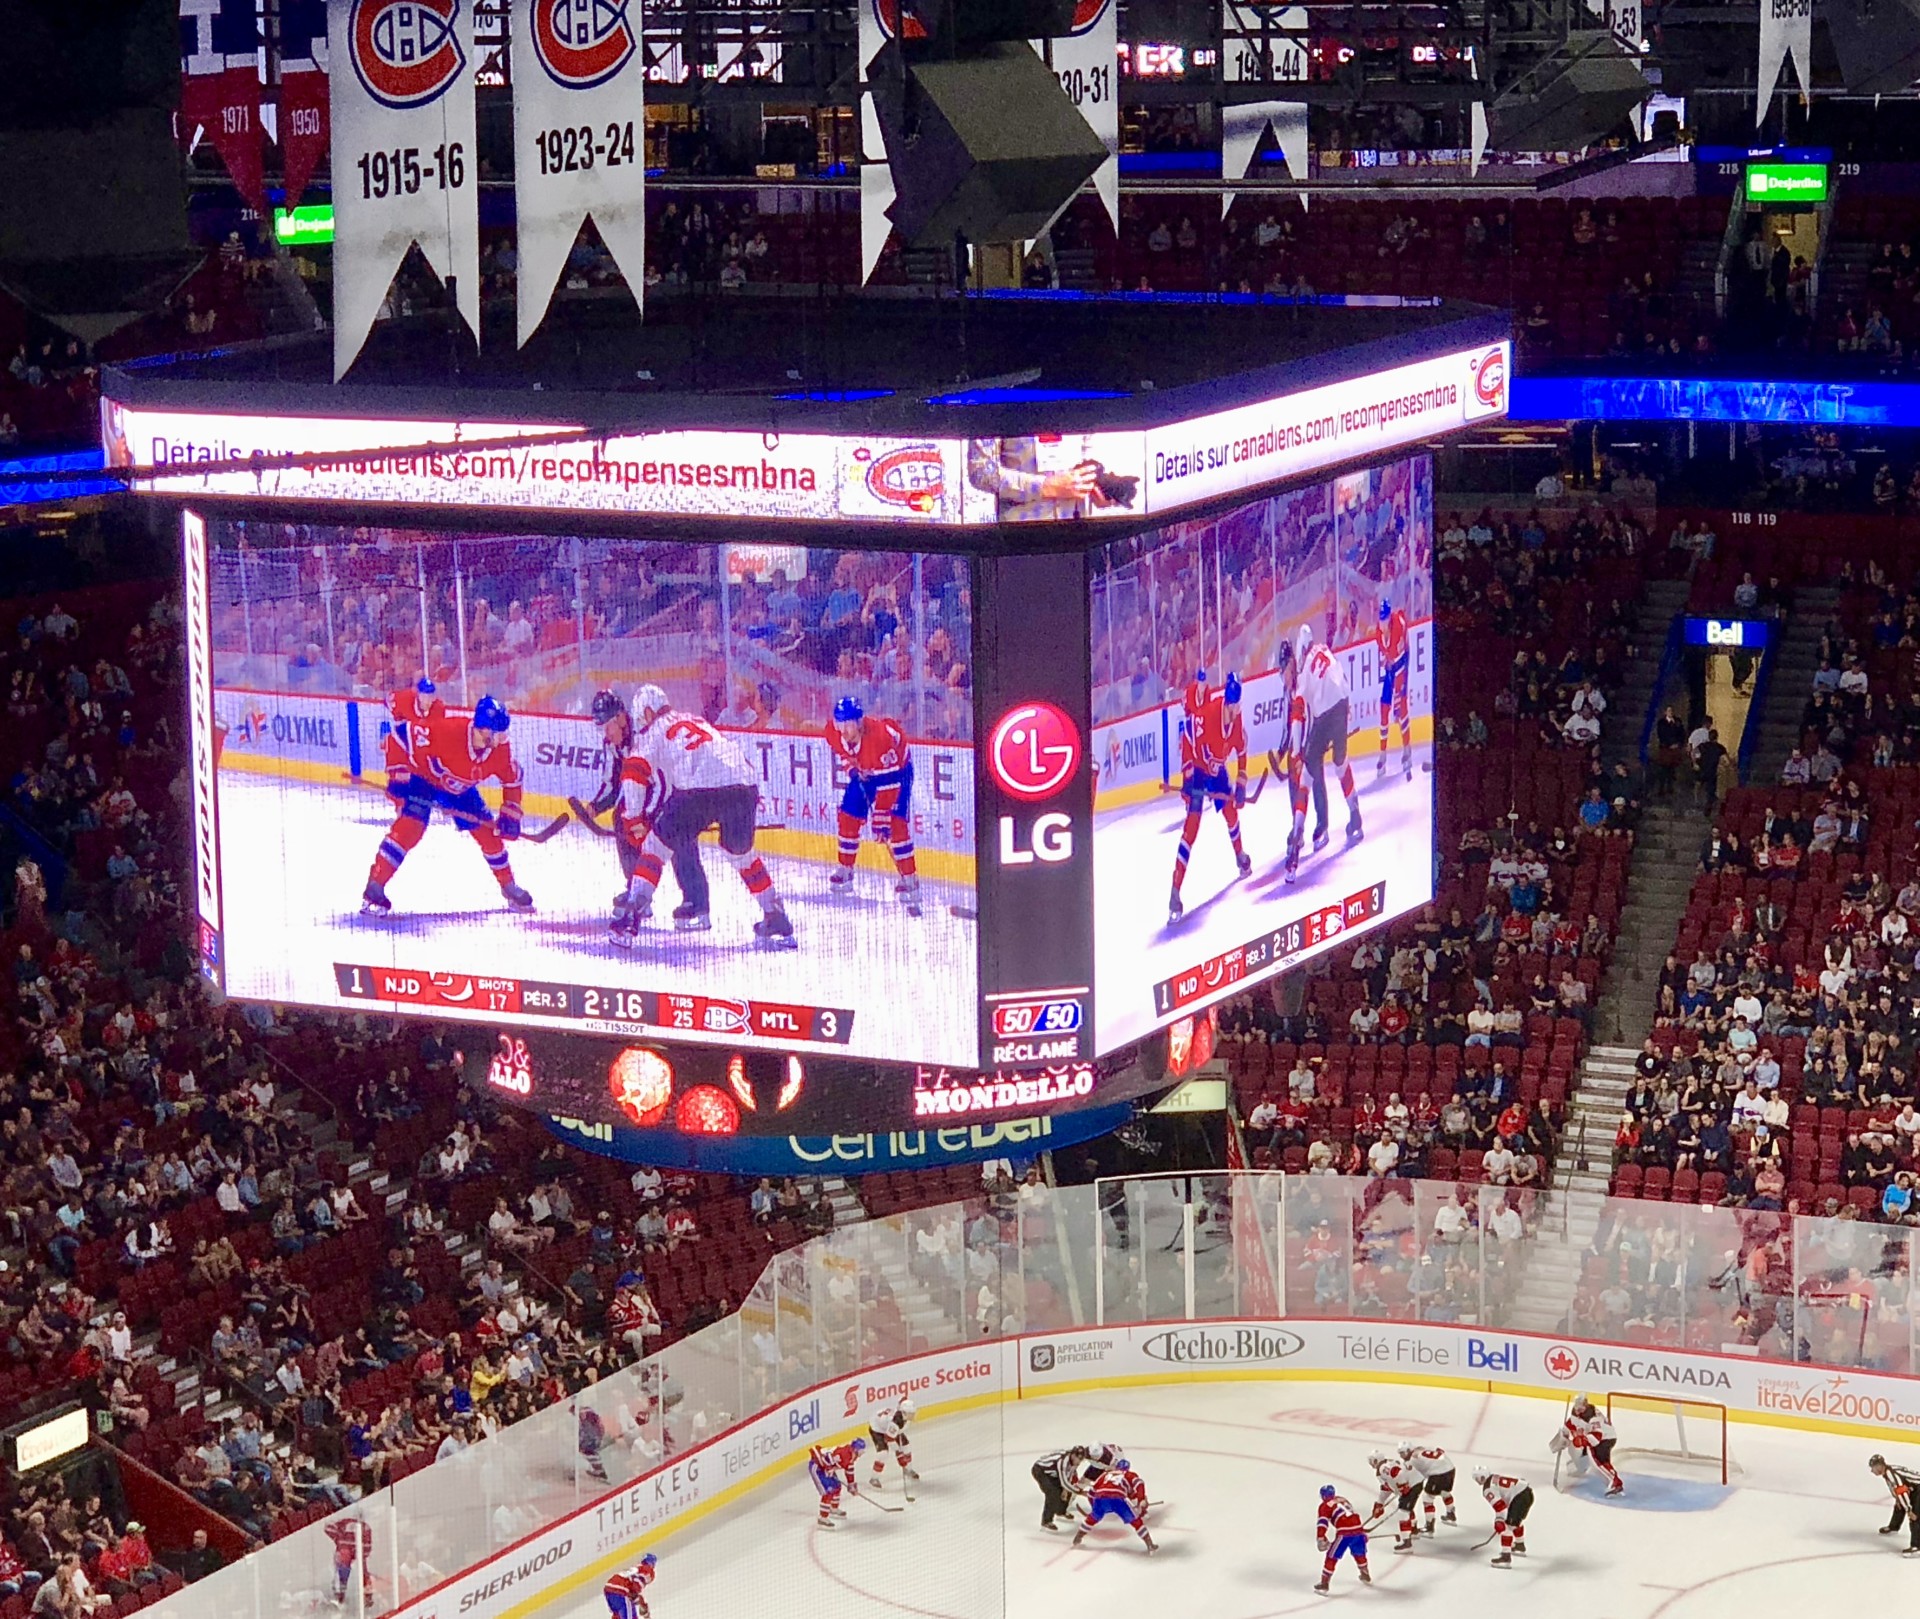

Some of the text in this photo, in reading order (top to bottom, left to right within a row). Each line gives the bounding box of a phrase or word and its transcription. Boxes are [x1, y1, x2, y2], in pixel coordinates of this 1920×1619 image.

[222, 105, 249, 133] 1971
[291, 108, 320, 136] 1950
[535, 121, 634, 175] 1923-24
[357, 142, 464, 199] 1915-16
[1719, 163, 1739, 174] 218
[1839, 163, 1860, 175] 219
[1768, 177, 1822, 190] Desjardins
[1207, 443, 1230, 470] sur
[1233, 382, 1457, 463] canadiens.com/recompensesmbna
[1732, 512, 1777, 526] 118 119
[1706, 620, 1743, 646] Bell
[272, 714, 338, 748] OLYMEL
[1123, 731, 1157, 769] OLYMEL
[1000, 813, 1072, 865] LG
[1348, 887, 1379, 920] MTL 3
[1260, 944, 1266, 960] 3
[1273, 924, 1300, 958] 2:16
[1312, 926, 1321, 943] 25
[350, 968, 420, 995] 1 NJD
[478, 979, 515, 993] SHOTS
[1229, 963, 1239, 982] 17
[489, 994, 507, 1010] 17
[557, 994, 567, 1008] 3
[584, 990, 643, 1019] 2:16
[668, 996, 694, 1009] TIRS
[1161, 976, 1197, 1010] 1 NJD
[602, 1021, 646, 1034] TISSOT
[673, 1010, 693, 1028] 25
[761, 1011, 836, 1037] MTL 3
[994, 1037, 1078, 1063] RÉCLAMÉ
[915, 1070, 1093, 1115] MONDELLO
[1057, 1341, 1113, 1354] APPLICATION
[1057, 1351, 1104, 1363] OFFICIELLE
[1160, 1330, 1287, 1361] Techo-Bloc
[1337, 1335, 1449, 1365] Télé Fibe
[1468, 1338, 1518, 1372] Bell
[866, 1361, 991, 1403] Banque Scotia
[1584, 1357, 1731, 1388] AIR CANADA
[789, 1399, 820, 1441] Bell
[722, 1430, 781, 1478] Télé Fibe
[597, 1458, 699, 1532] THE KEG
[459, 1539, 572, 1613] SHER-WOOD
